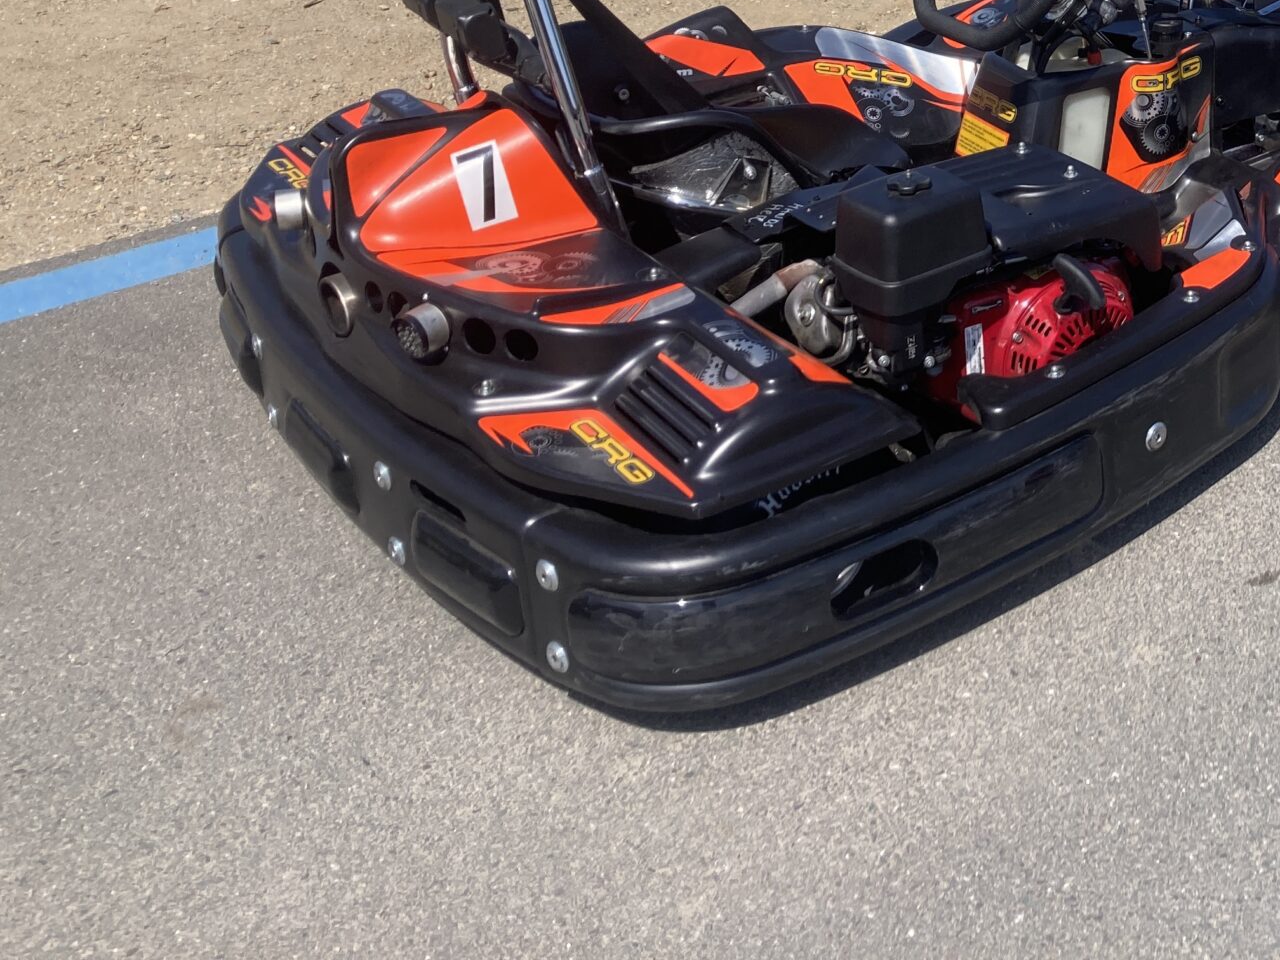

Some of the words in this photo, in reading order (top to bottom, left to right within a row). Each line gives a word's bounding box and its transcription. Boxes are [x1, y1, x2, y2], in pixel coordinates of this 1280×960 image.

[813, 61, 913, 89] CRG
[455, 143, 496, 224] 7
[568, 418, 656, 485] CRG
